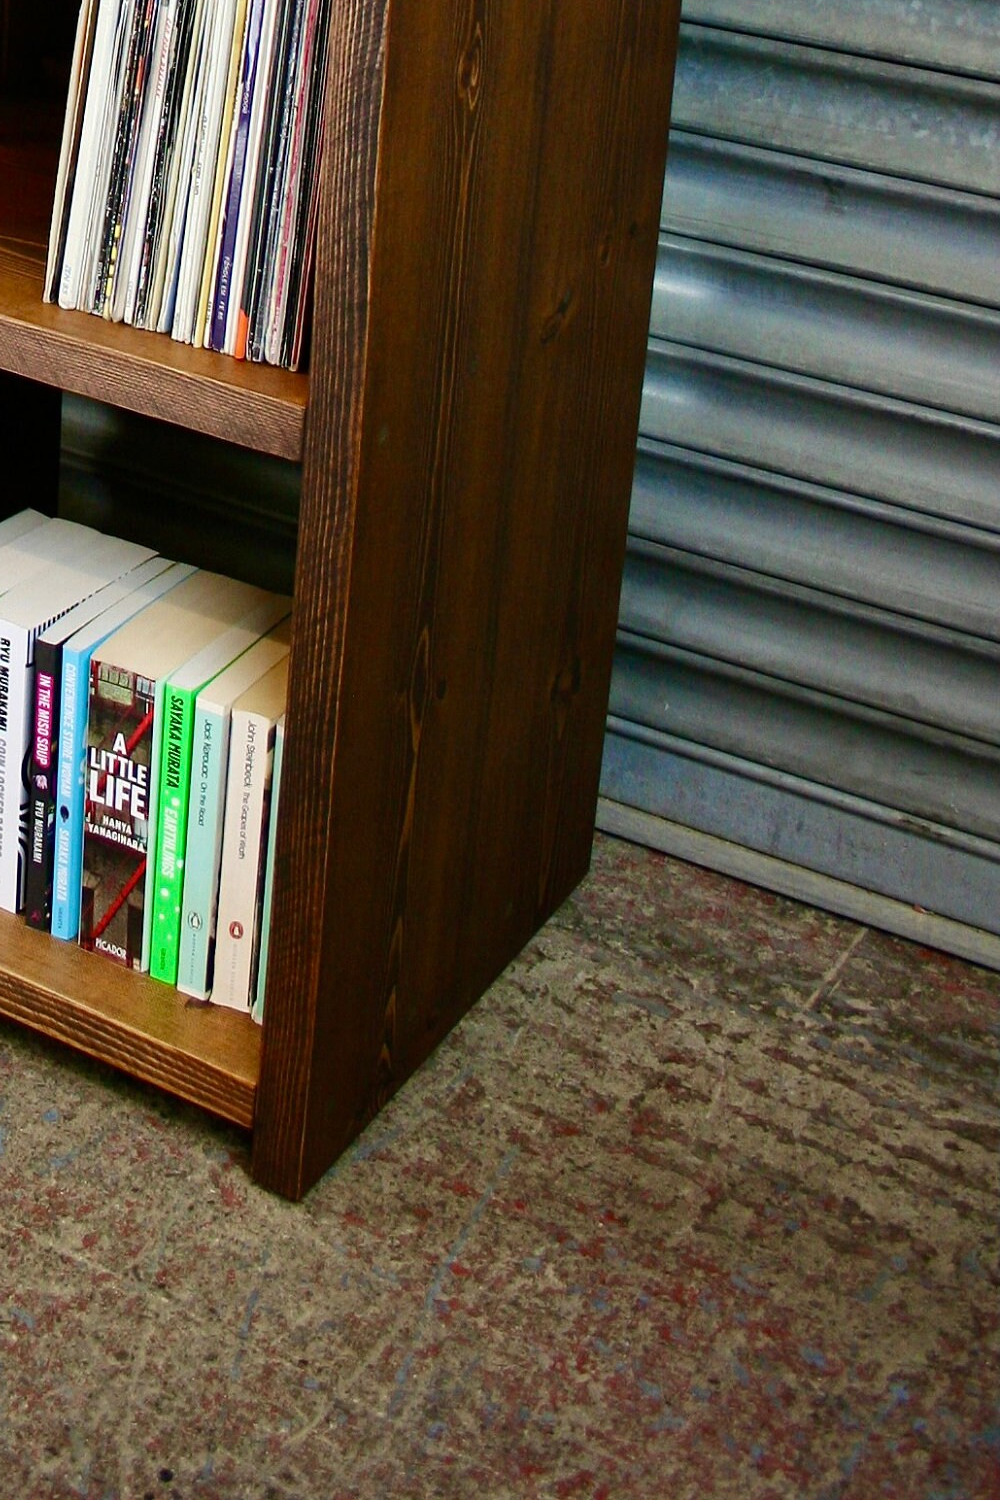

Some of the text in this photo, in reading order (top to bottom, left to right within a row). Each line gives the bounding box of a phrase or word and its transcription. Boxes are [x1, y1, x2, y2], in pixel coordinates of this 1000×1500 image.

[0, 637, 11, 663] RYU
[35, 672, 52, 766] IN THE MISO SOUP
[60, 661, 76, 798] CONVENIENCE STORE WOMAN
[112, 732, 128, 756] A
[166, 694, 184, 789] SAYAKA MURATA
[201, 718, 213, 779] Jack Kerouac
[243, 719, 257, 787] John Steinbeck
[90, 747, 148, 787] LITTLE
[89, 769, 147, 821] LIFE
[200, 781, 209, 795] On
[32, 799, 45, 864] RYU MURAKAMI
[101, 813, 133, 836] HANYA
[198, 807, 206, 827] Road
[240, 829, 246, 839] of
[241, 804, 250, 830] Grapes
[87, 822, 146, 854] YANAGIHARA
[161, 806, 178, 880] EARTHLINGS
[56, 827, 70, 902] SAYAKA MURATA
[95, 937, 127, 961] PICADOR
